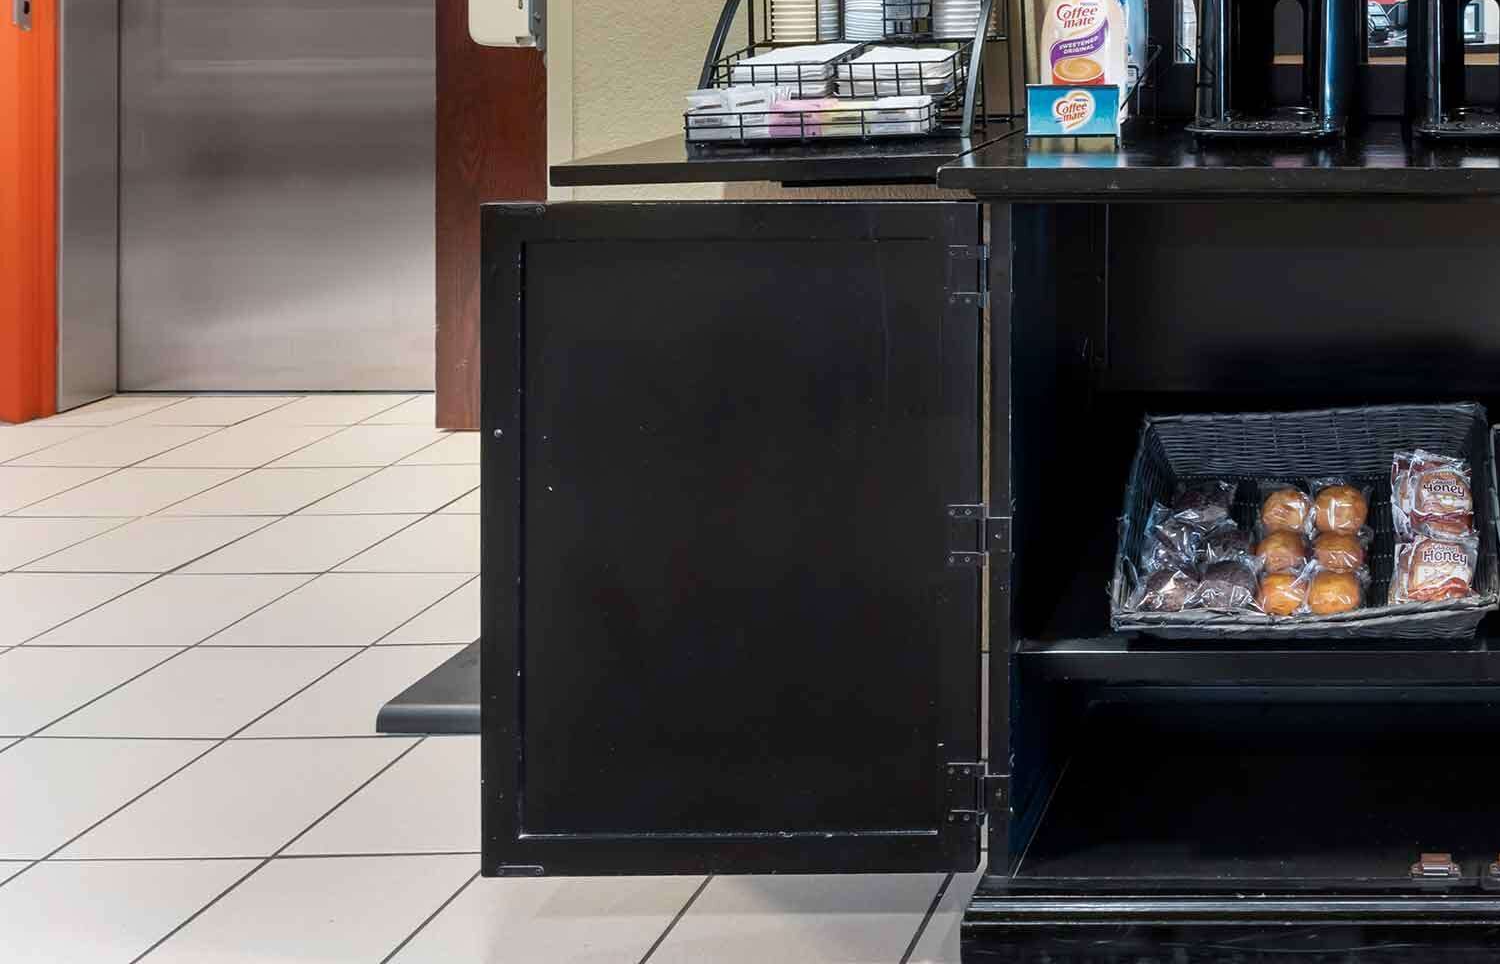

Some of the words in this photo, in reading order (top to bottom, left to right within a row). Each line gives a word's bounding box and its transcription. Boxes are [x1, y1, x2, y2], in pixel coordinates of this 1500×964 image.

[1056, 3, 1098, 22] Coffee
[1064, 16, 1095, 28] mate
[1056, 100, 1088, 115] Coffee
[1064, 112, 1086, 121] mate
[1424, 483, 1465, 497] Honey
[1424, 550, 1467, 565] Honey
